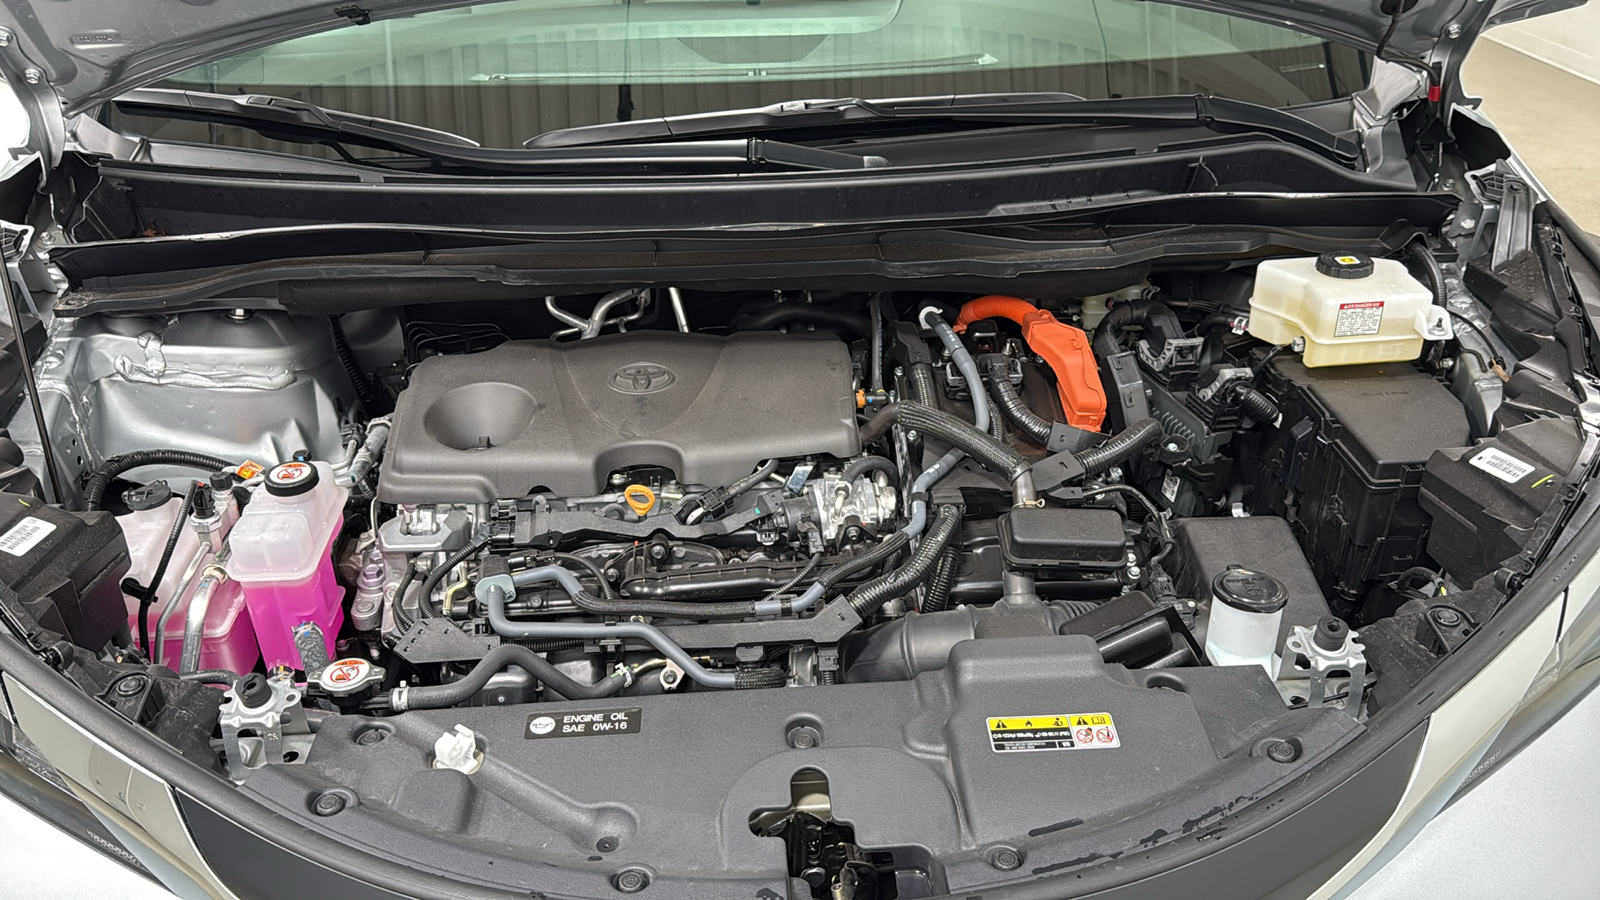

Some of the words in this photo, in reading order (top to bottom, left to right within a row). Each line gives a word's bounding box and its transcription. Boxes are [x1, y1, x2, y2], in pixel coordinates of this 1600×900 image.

[563, 713, 604, 723] ENGINE
[610, 712, 629, 720] OIL
[562, 723, 586, 733] SAE
[592, 721, 628, 731] 0W-16
